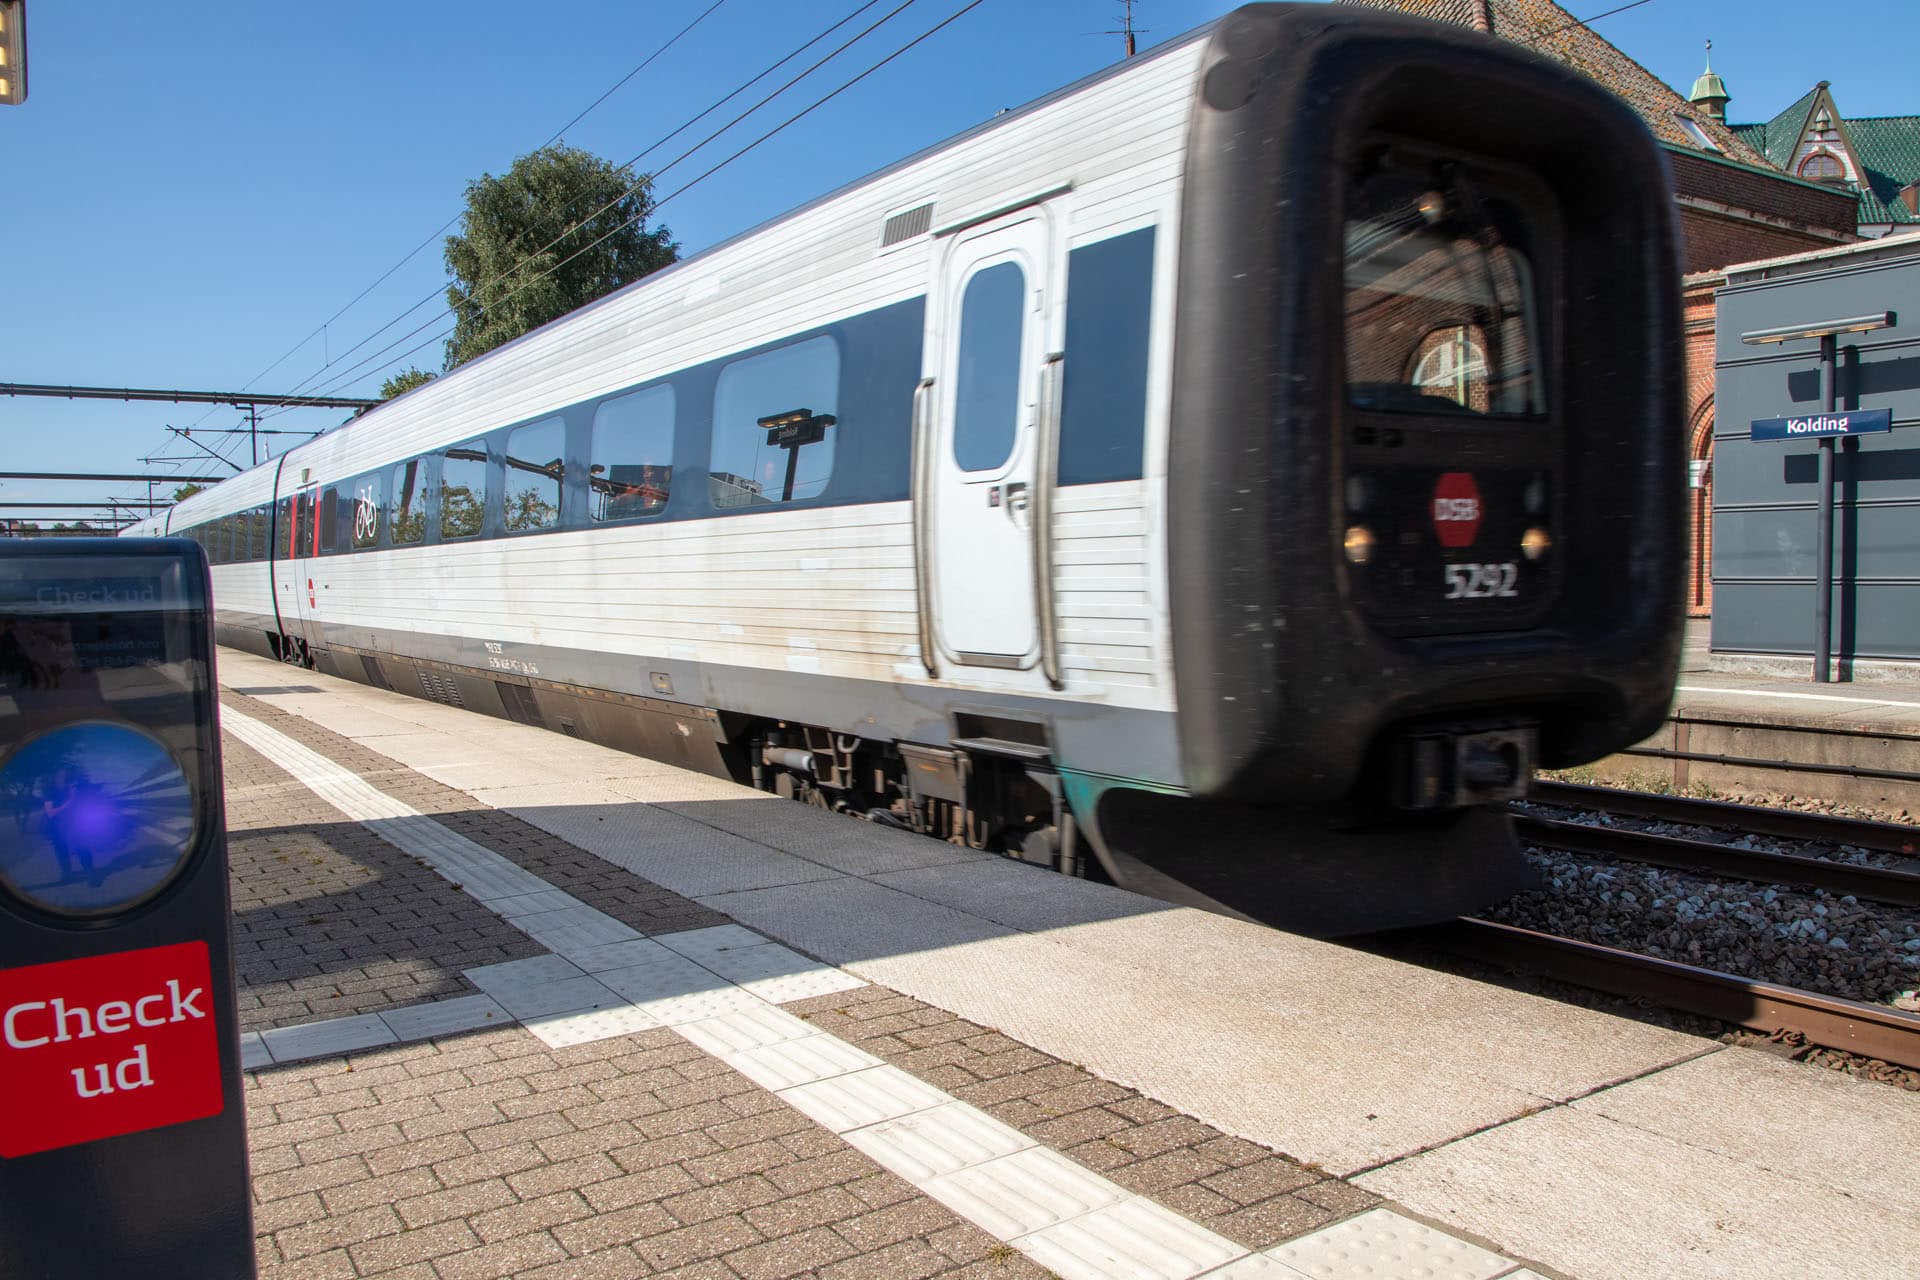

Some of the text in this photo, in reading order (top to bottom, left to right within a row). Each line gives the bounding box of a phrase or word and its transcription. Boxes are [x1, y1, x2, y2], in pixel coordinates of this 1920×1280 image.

[1786, 417, 1848, 434] Kolding
[1434, 498, 1480, 521] DSB
[36, 585, 154, 605] Check ud
[1445, 563, 1519, 598] 5292
[3, 979, 206, 1049] Check
[71, 1044, 154, 1098] ud
